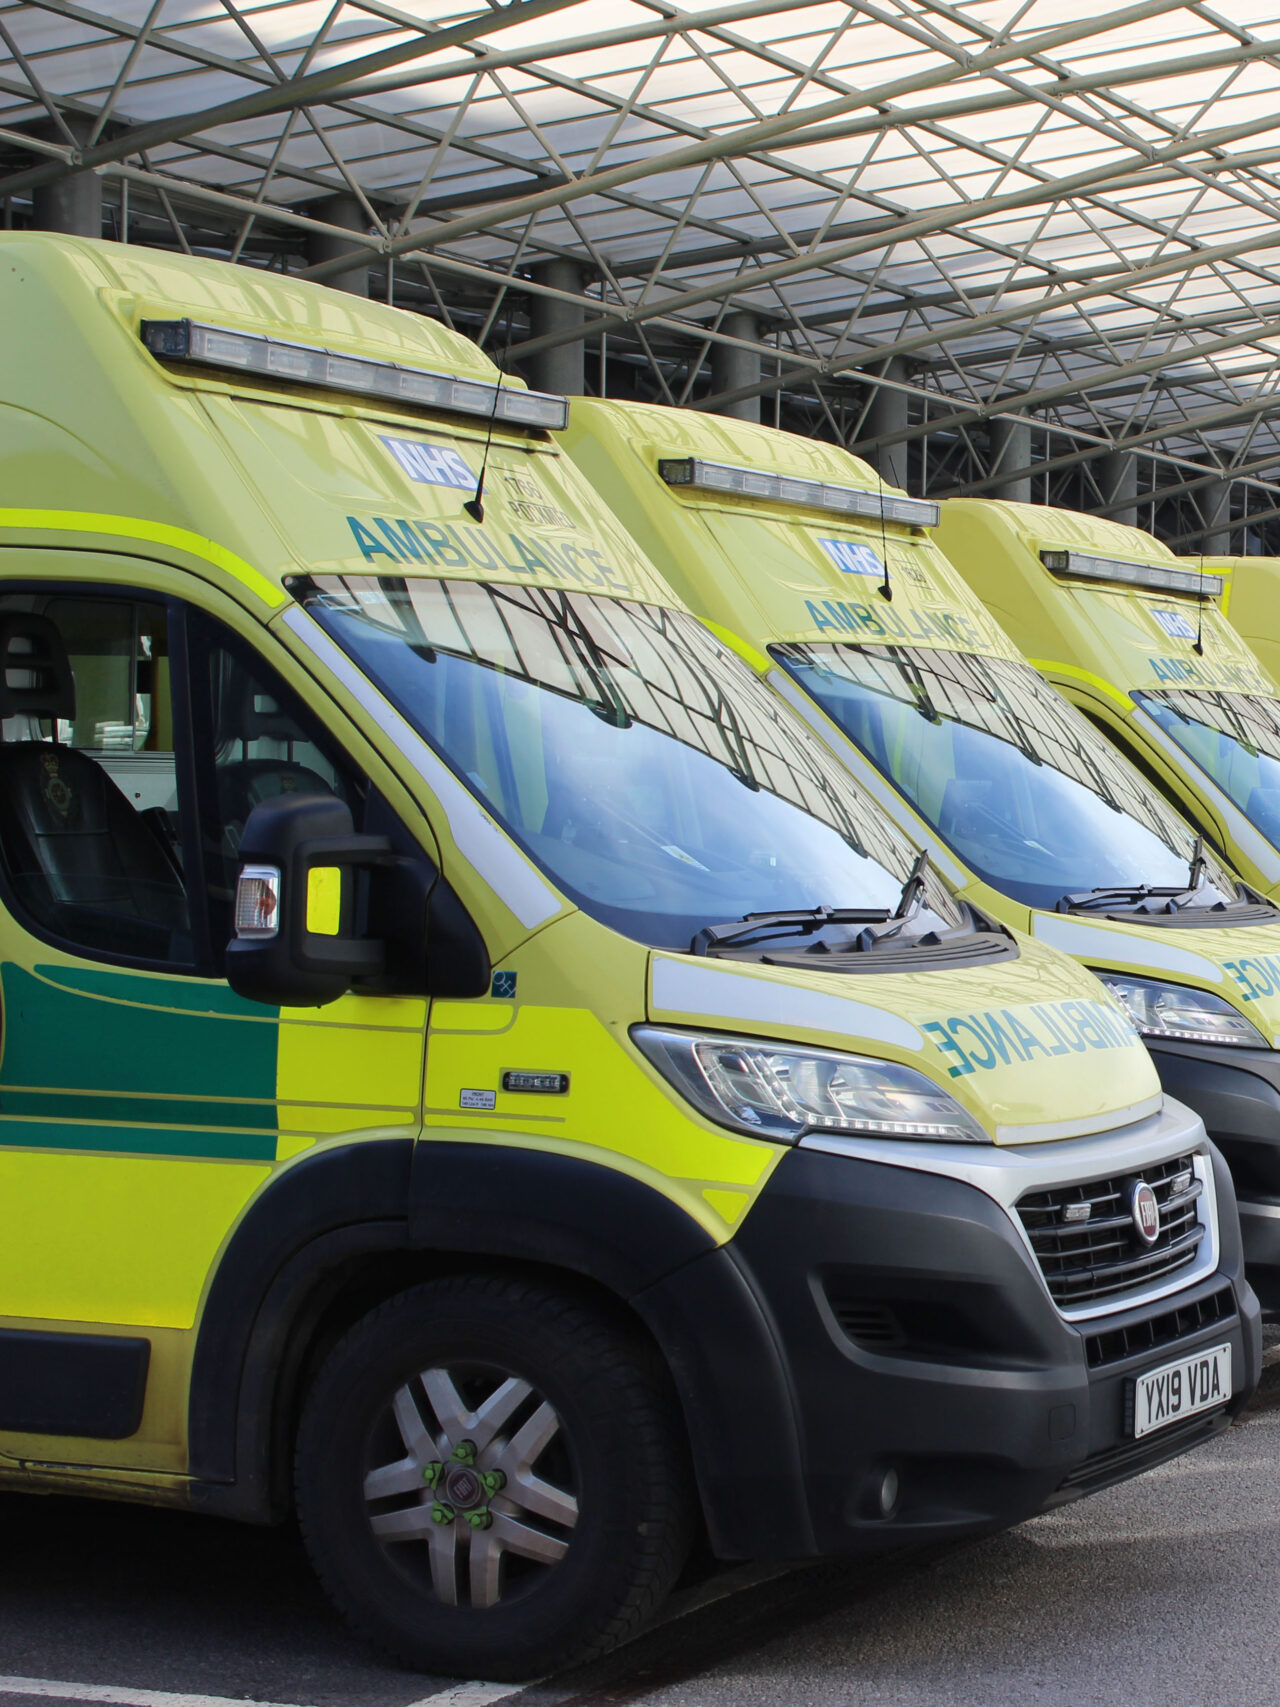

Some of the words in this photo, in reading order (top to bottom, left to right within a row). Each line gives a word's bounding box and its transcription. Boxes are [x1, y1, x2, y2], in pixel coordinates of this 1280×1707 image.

[388, 439, 479, 490] NHS
[346, 516, 632, 592] AMBULANCE
[824, 541, 884, 576] NHS
[804, 600, 990, 648] AMBULANCE
[1152, 610, 1197, 638] NHS
[1145, 1369, 1182, 1425] YX19
[1187, 1355, 1221, 1407] VDA
